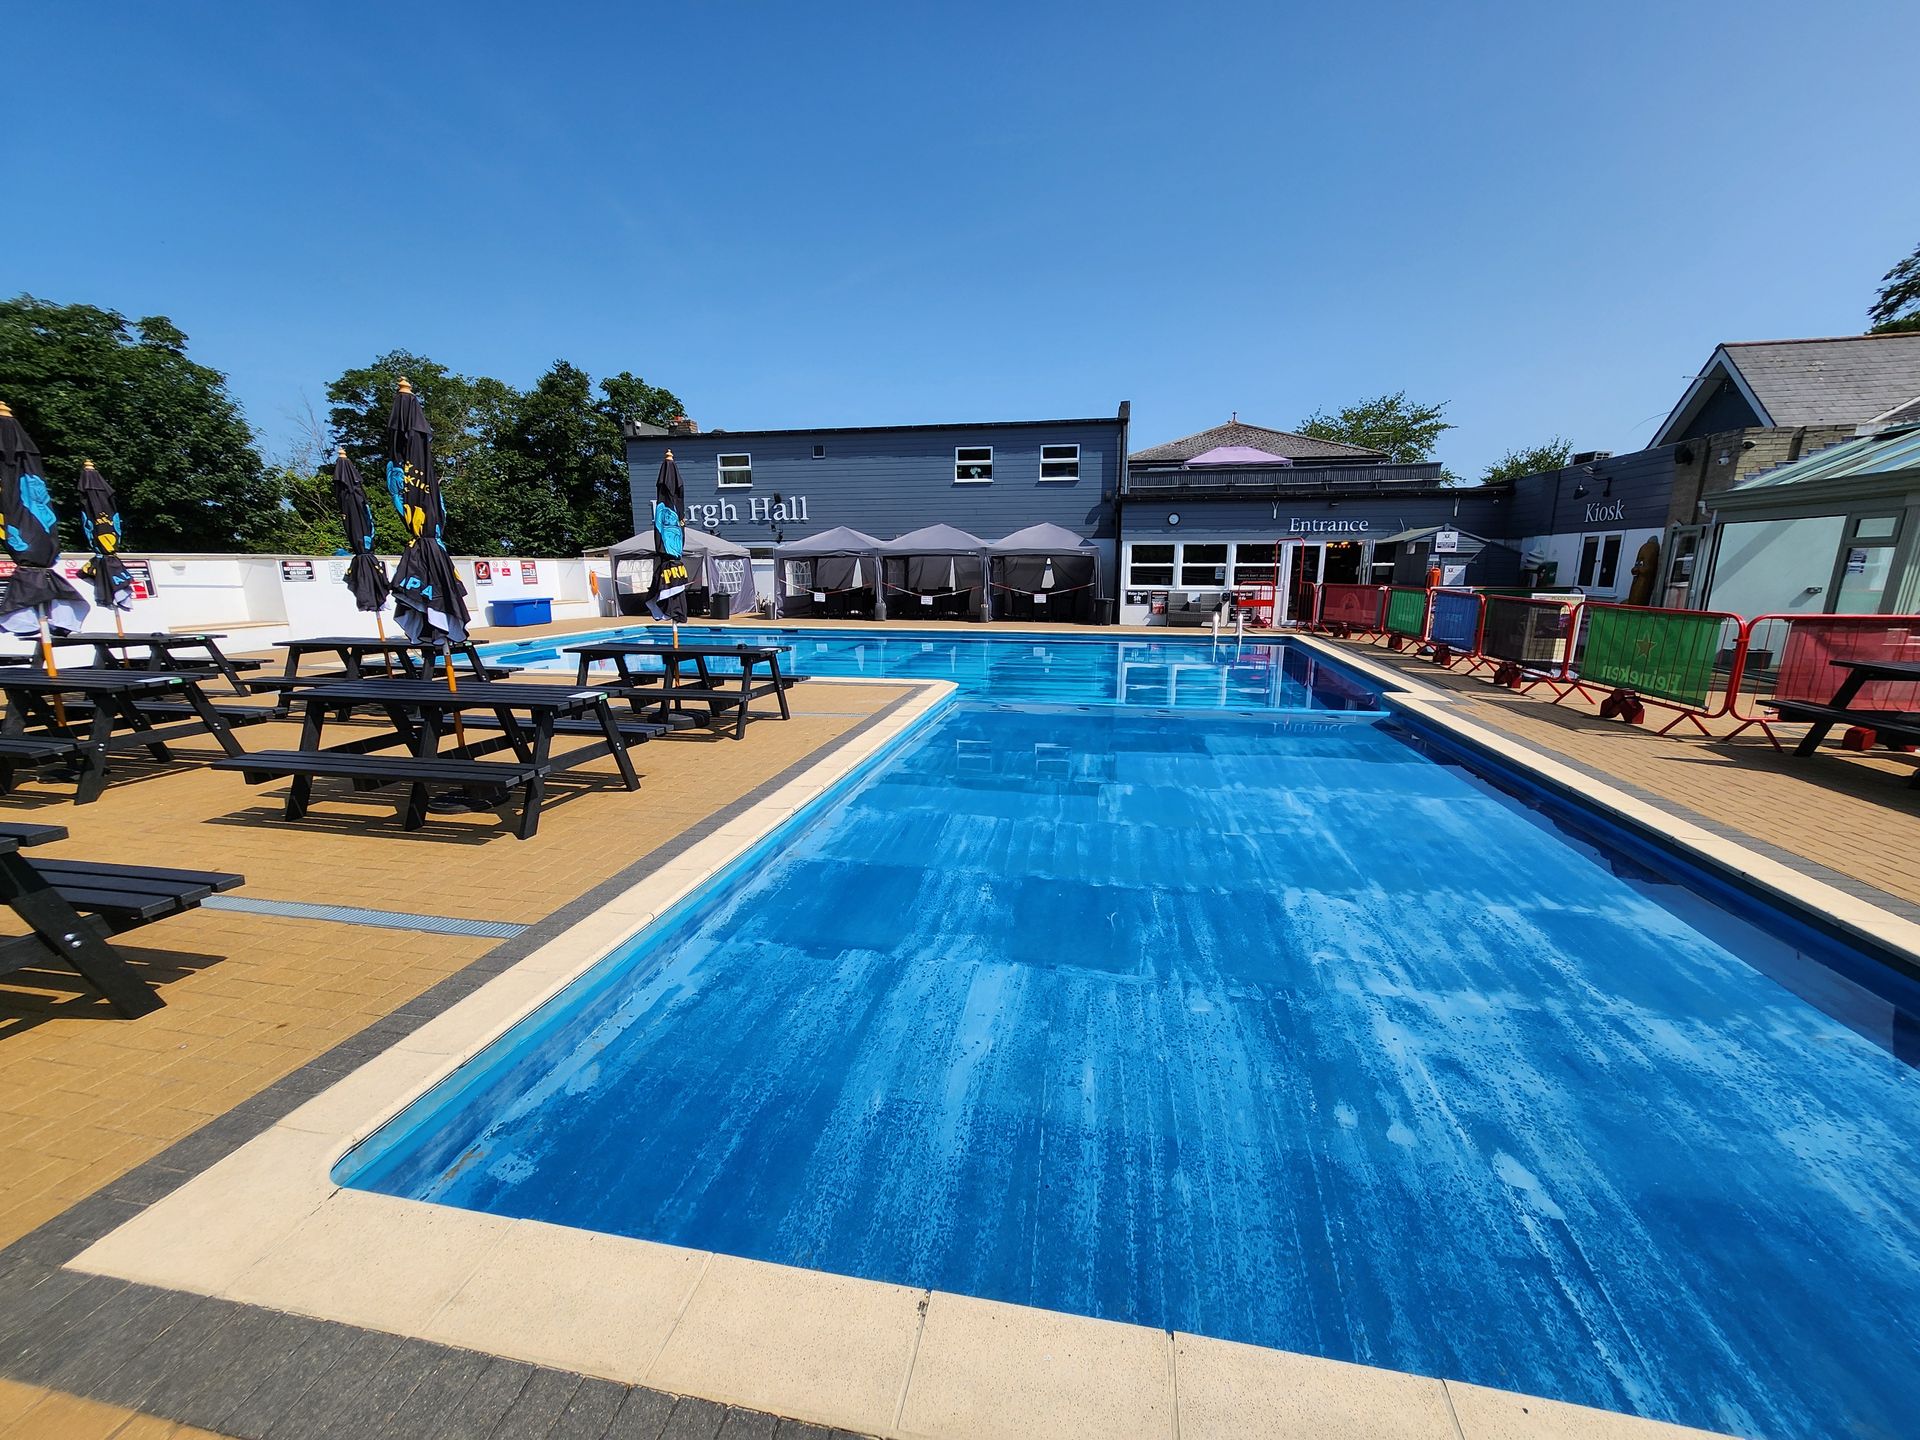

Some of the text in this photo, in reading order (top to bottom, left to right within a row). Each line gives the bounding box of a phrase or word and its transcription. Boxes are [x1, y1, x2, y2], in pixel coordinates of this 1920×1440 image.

[650, 496, 809, 528] rgh Hall
[1584, 499, 1625, 523] Kiosk
[1289, 517, 1369, 532] Entrance
